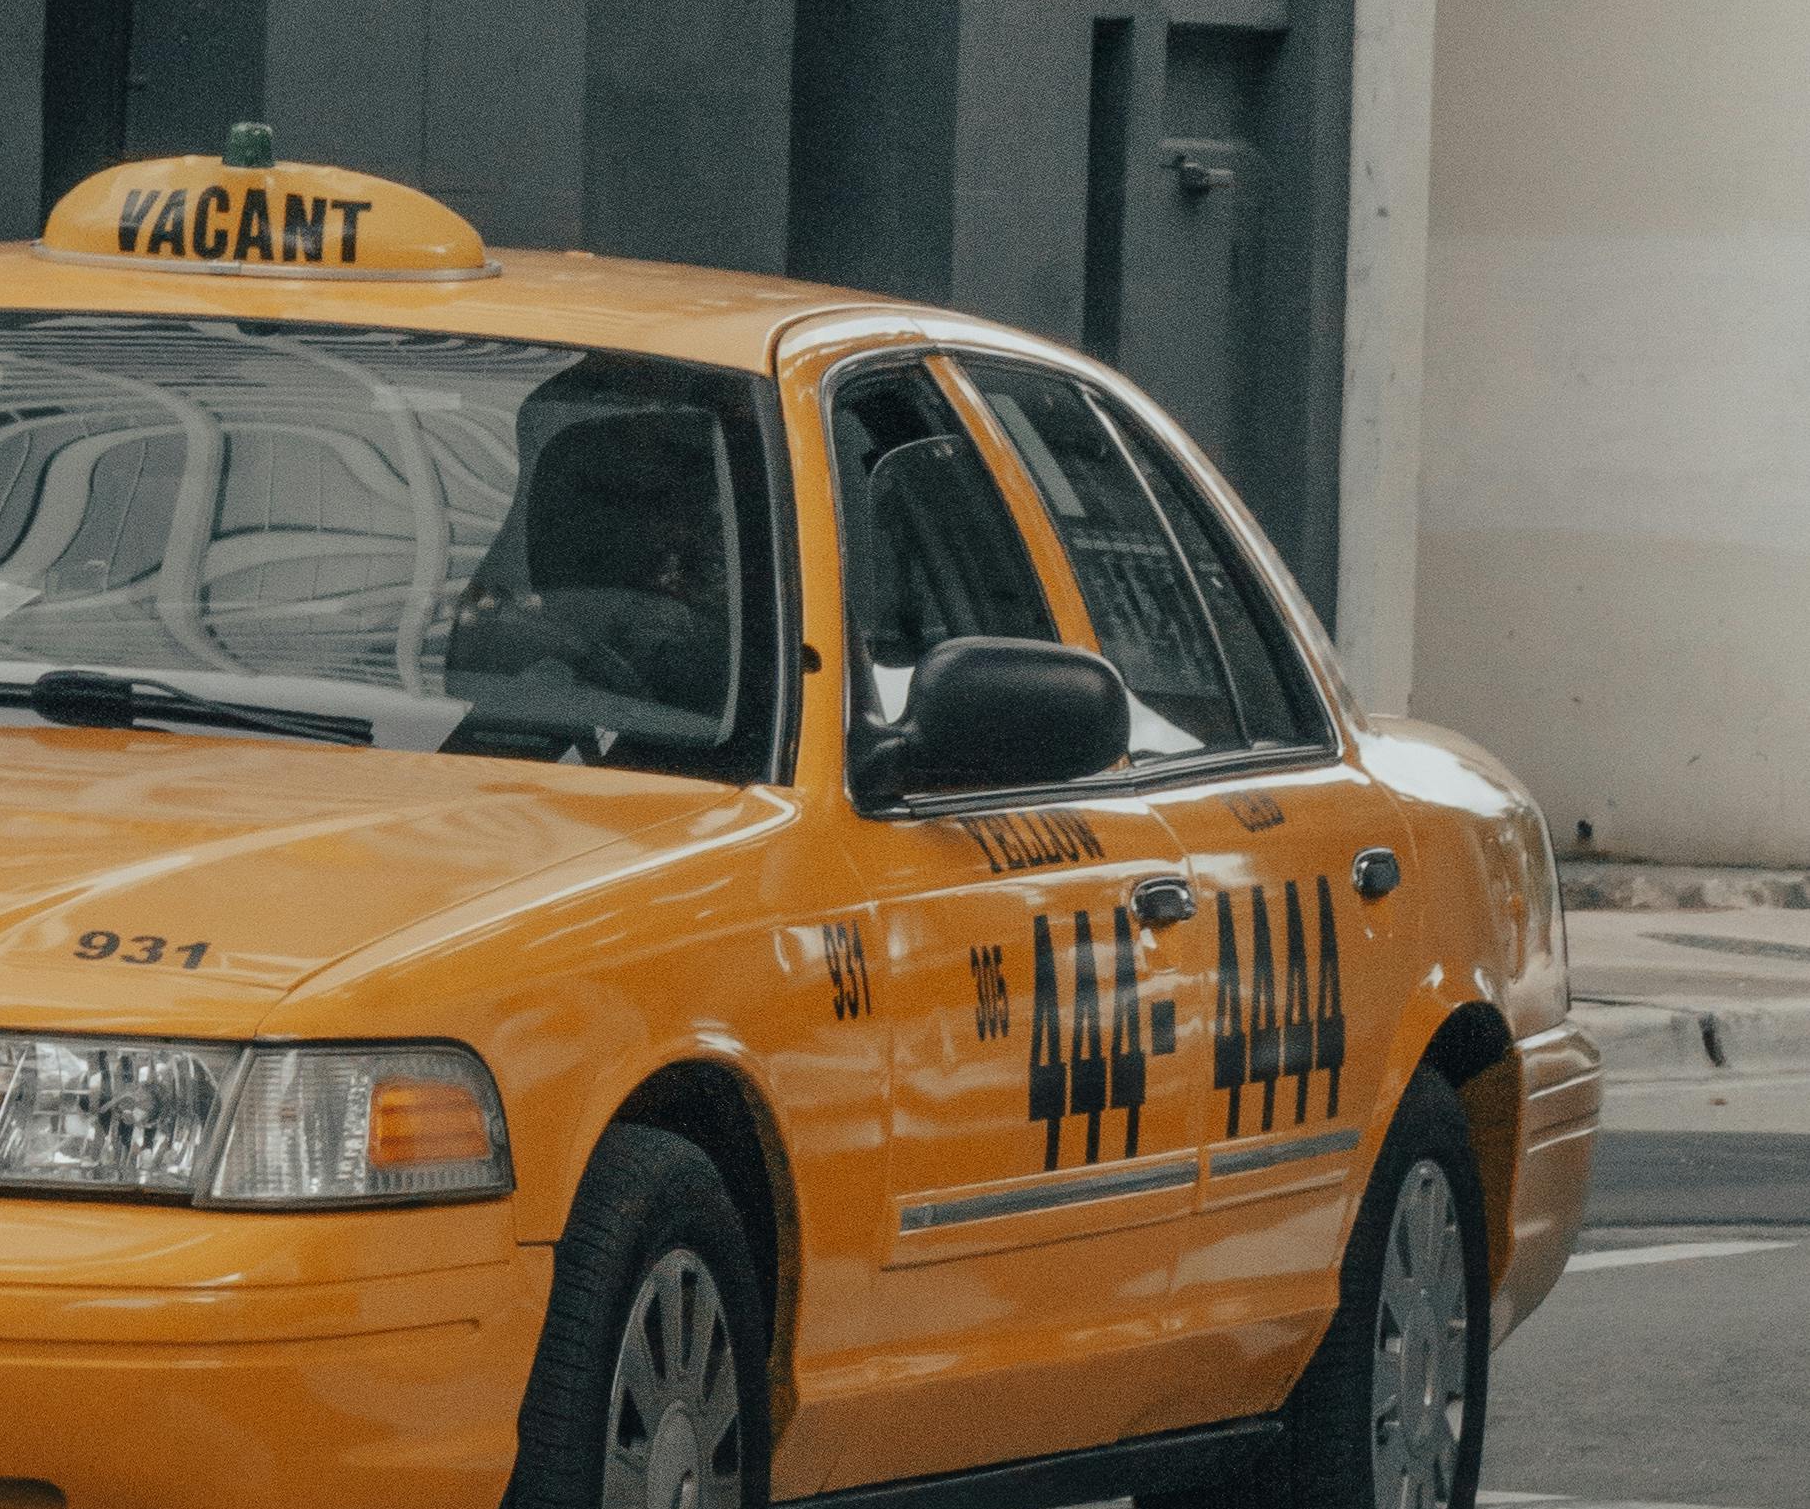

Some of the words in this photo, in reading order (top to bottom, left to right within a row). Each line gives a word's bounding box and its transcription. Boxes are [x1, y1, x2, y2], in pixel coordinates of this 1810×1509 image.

[117, 185, 372, 263] VACANT
[957, 806, 1105, 874] YELLOW
[73, 930, 212, 970] 931
[822, 919, 872, 1021] 931
